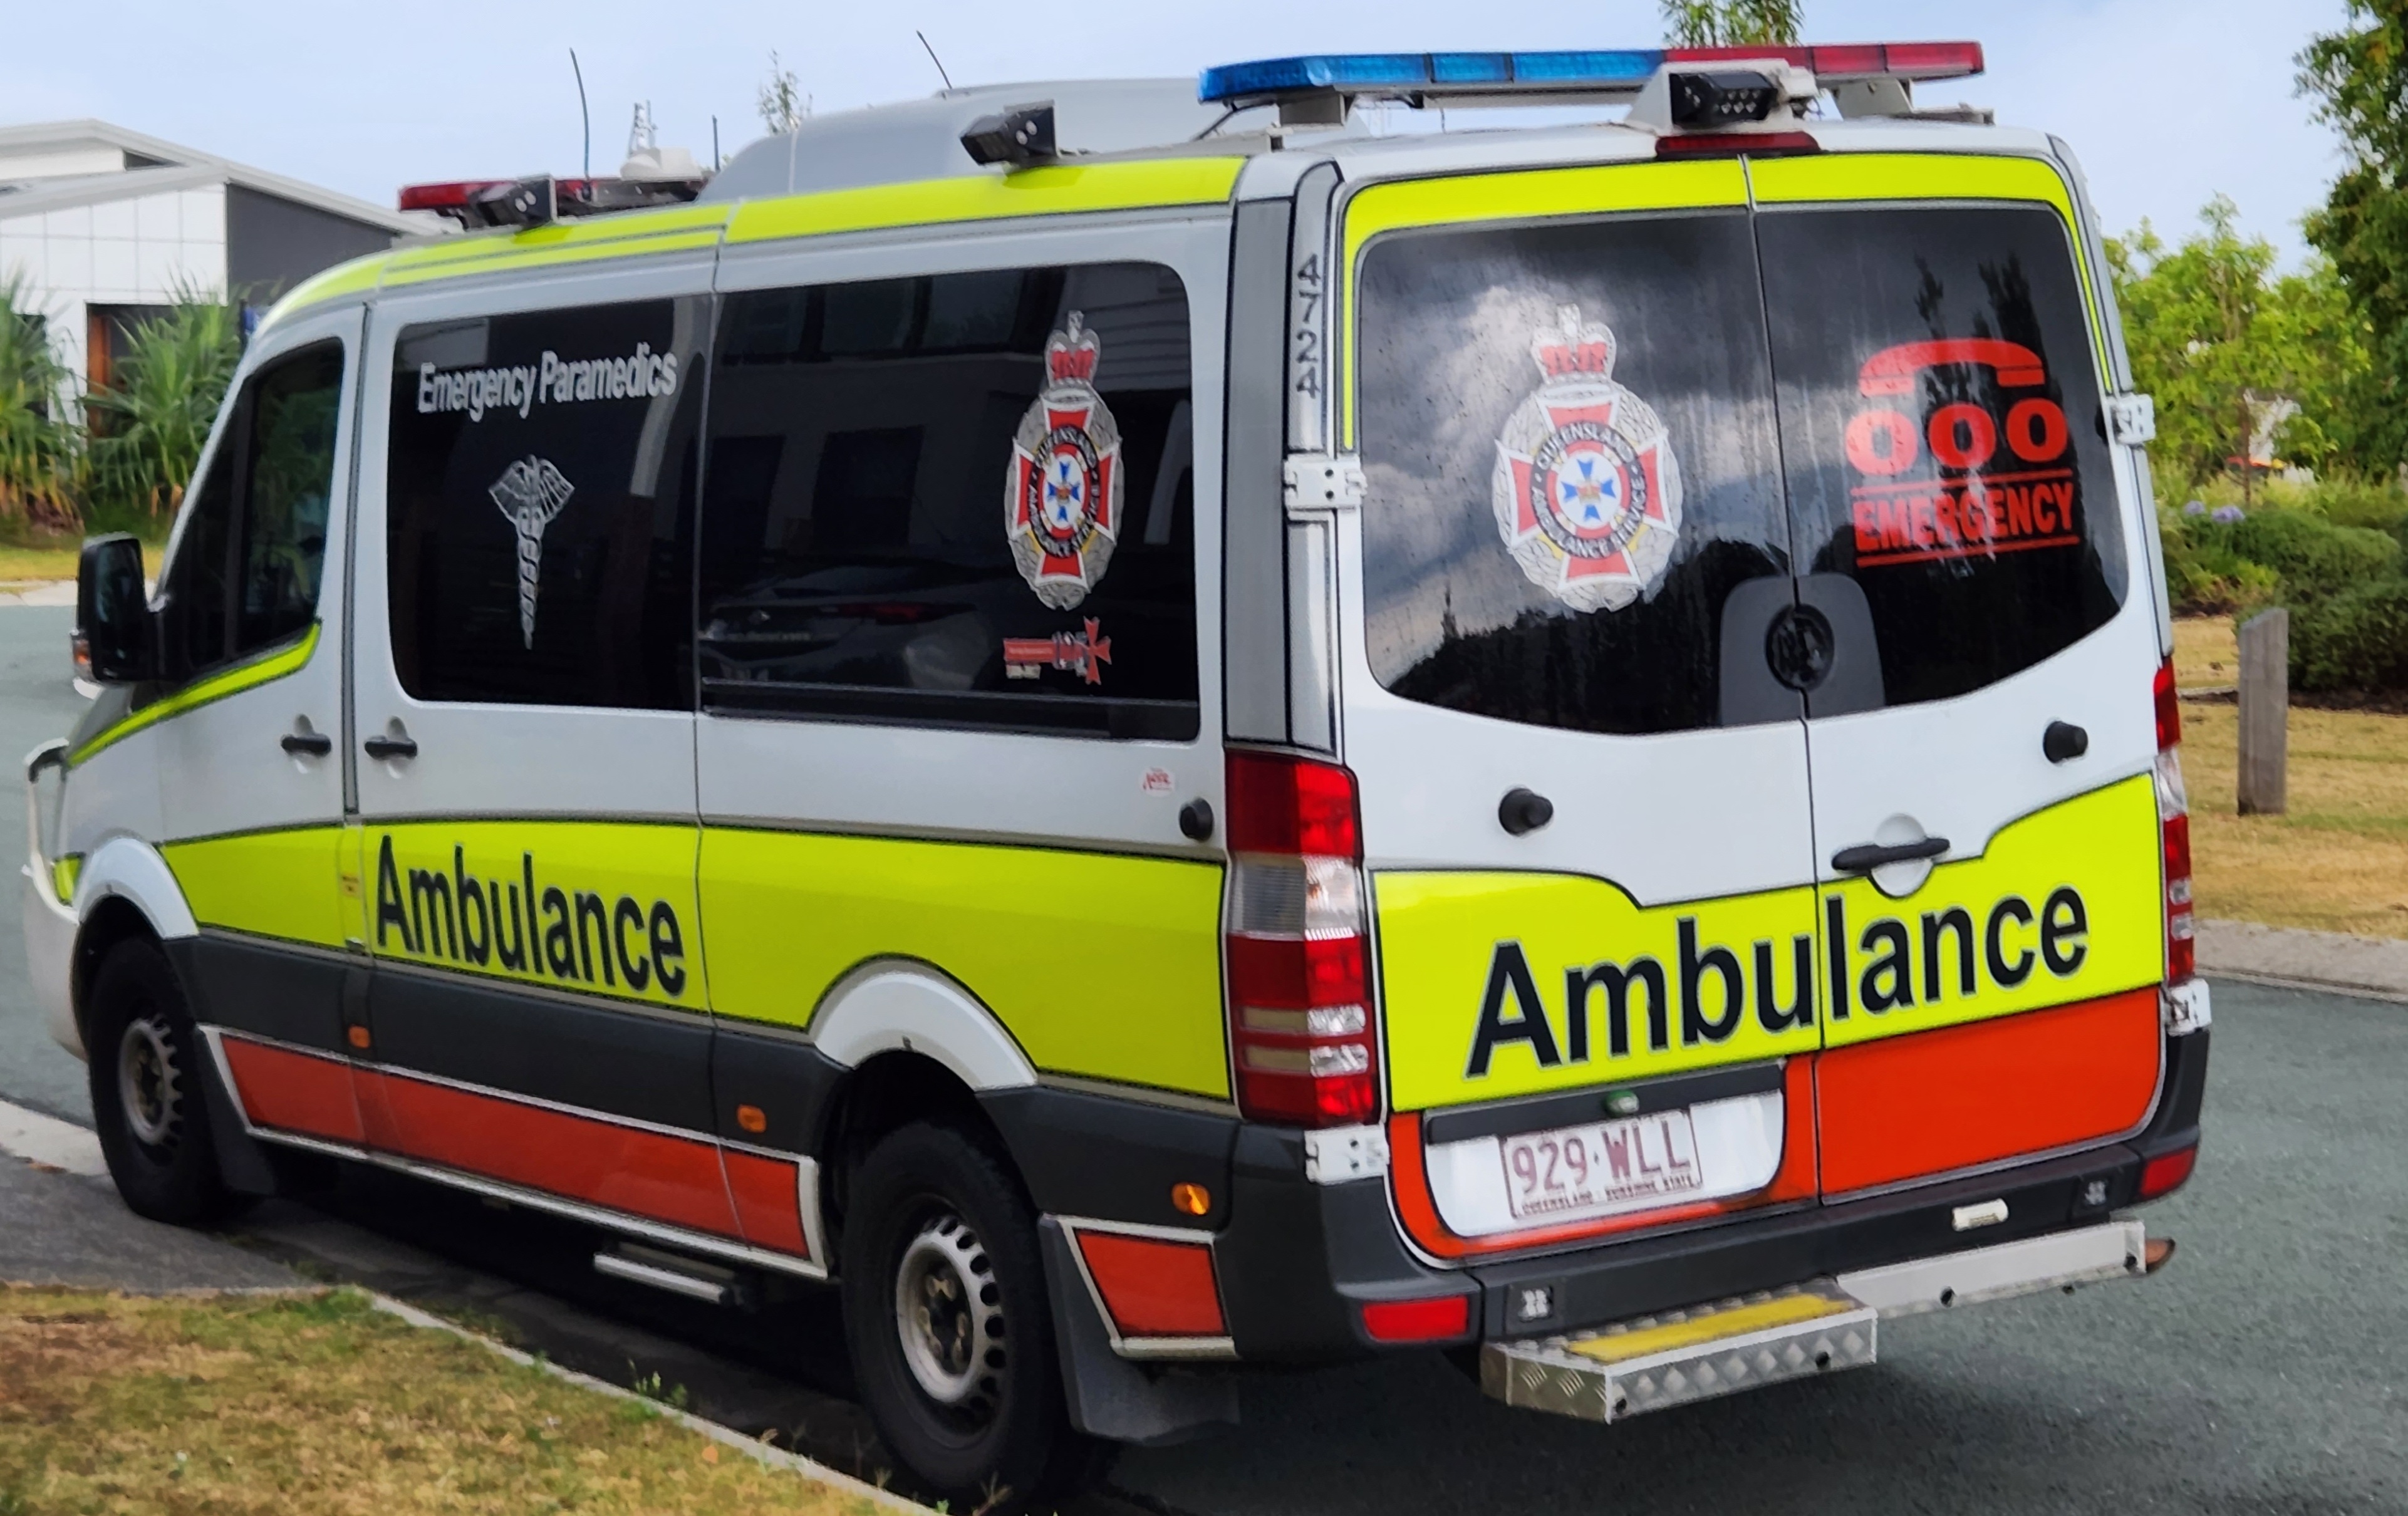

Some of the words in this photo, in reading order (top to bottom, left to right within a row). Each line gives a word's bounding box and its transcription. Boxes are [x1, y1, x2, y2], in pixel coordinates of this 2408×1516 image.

[418, 362, 536, 422] Emergency
[539, 341, 677, 403] Paramedics
[1295, 253, 1322, 399] 4724
[1852, 482, 2073, 551] EMERGENCY
[377, 834, 686, 996] Ambulance
[1465, 886, 2087, 1078] Ambulance
